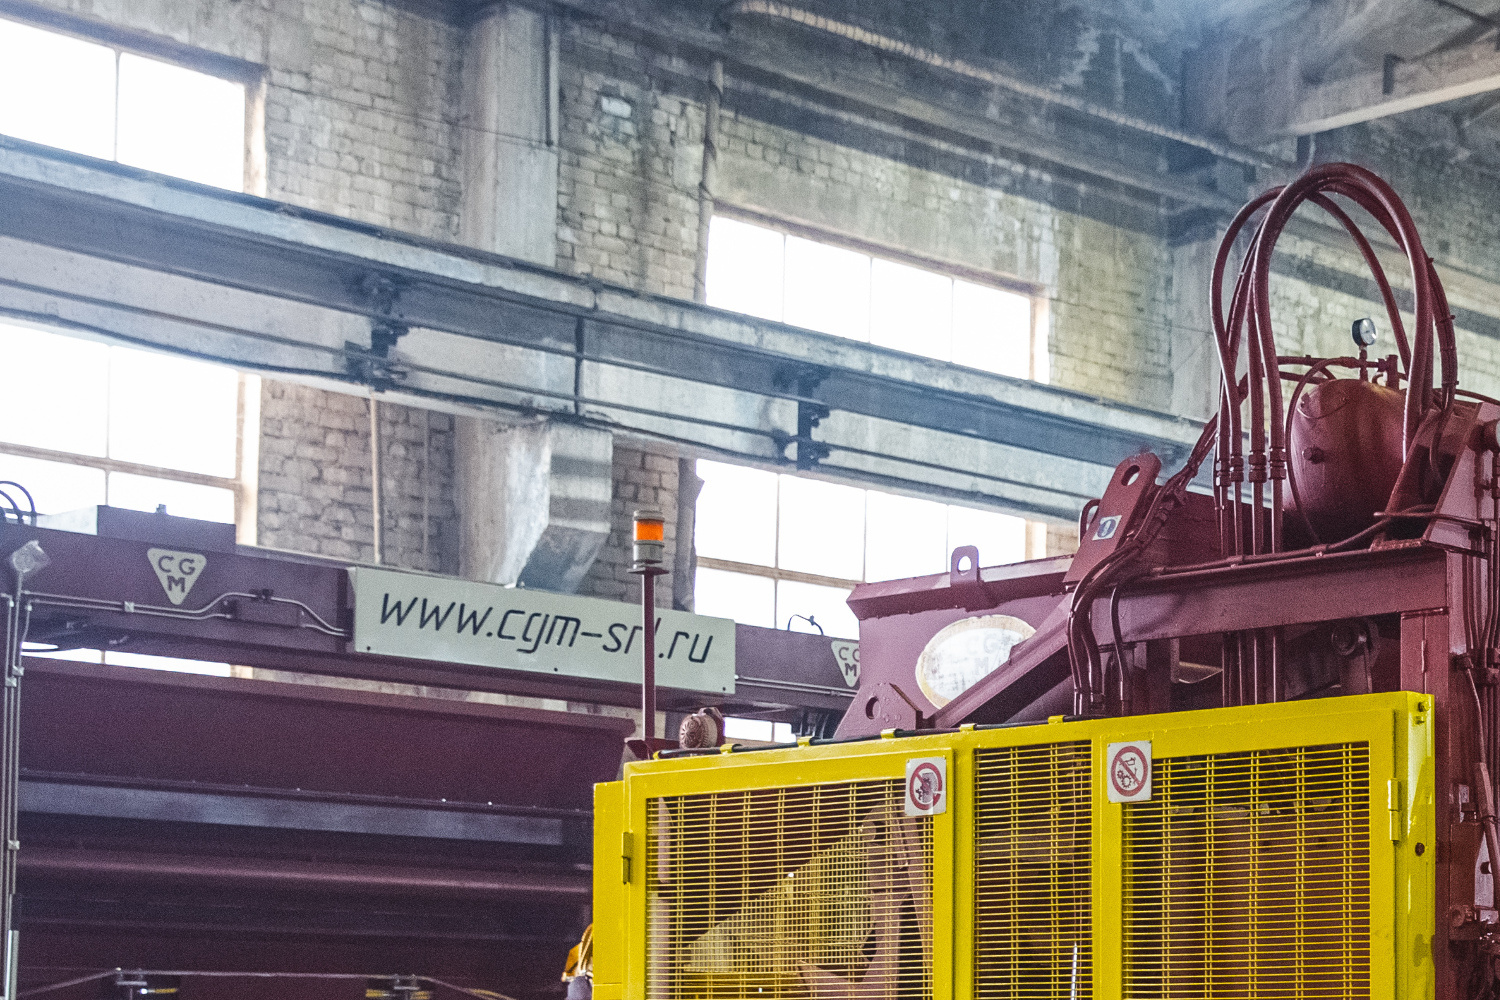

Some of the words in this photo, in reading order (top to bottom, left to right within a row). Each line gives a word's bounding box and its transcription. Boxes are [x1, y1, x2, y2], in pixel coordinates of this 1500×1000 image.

[158, 554, 196, 576] CG
[166, 574, 187, 594] M
[844, 662, 858, 678] M
